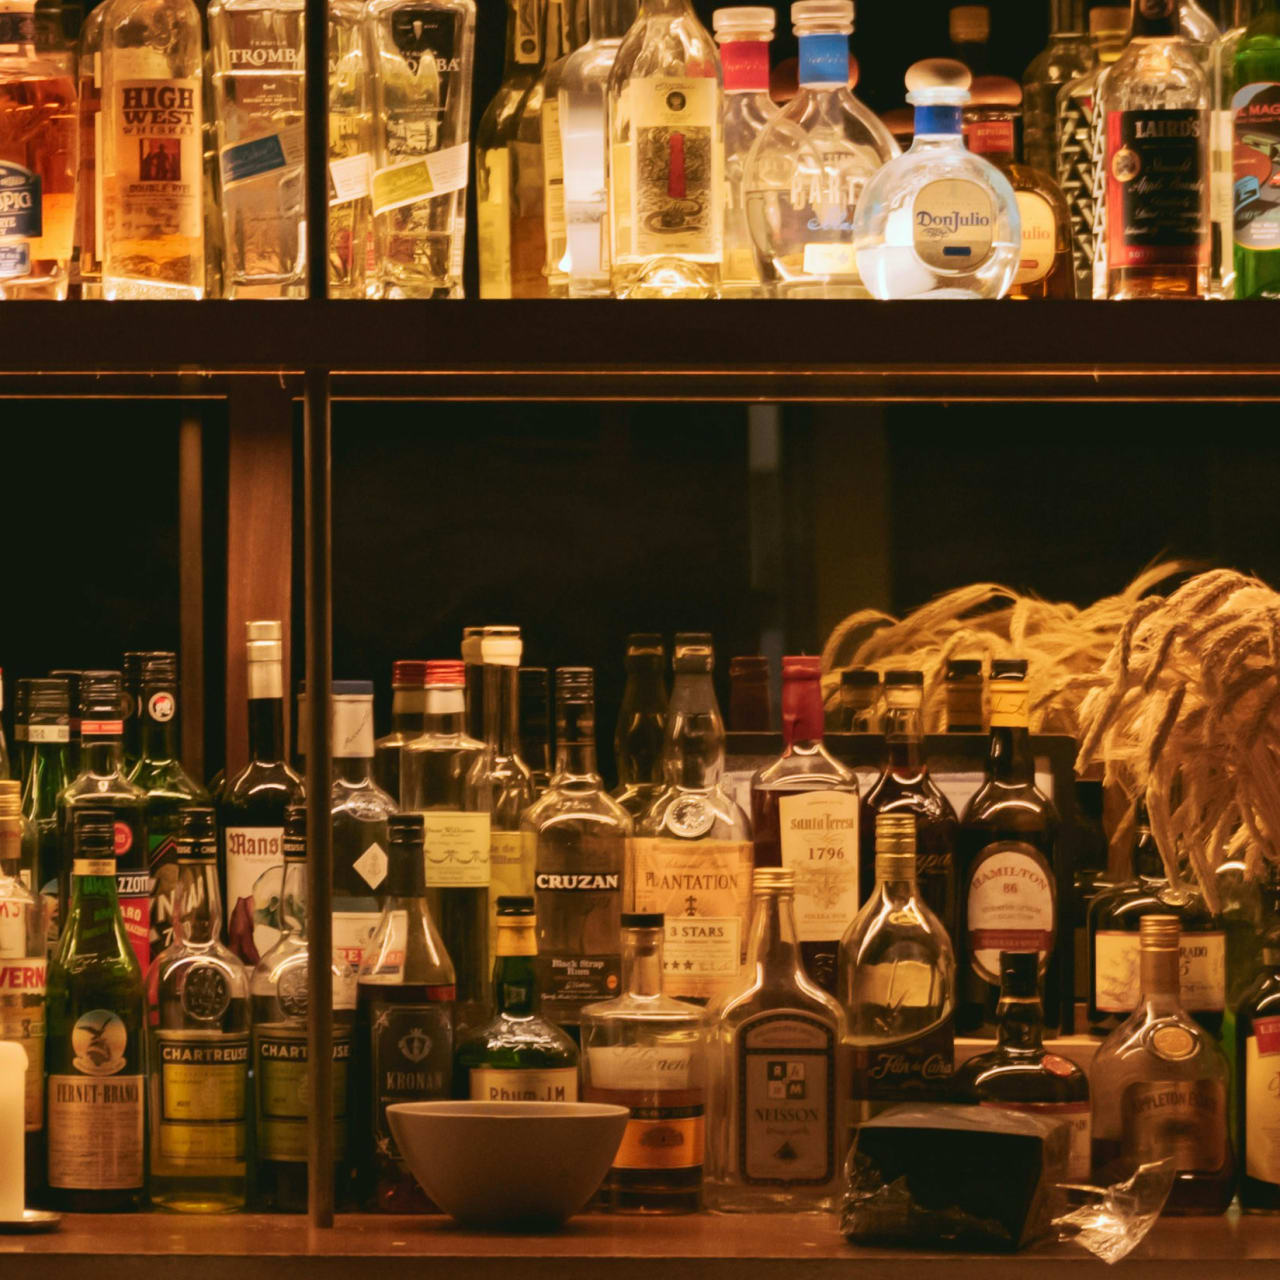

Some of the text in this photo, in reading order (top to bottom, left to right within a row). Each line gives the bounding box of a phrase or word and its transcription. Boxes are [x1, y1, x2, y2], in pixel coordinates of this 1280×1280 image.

[122, 86, 194, 110] HIGH
[123, 109, 194, 125] WEST
[1134, 118, 1201, 139] LAIRD'S
[1022, 227, 1051, 241] ulio
[807, 847, 846, 861] 1796
[535, 873, 619, 890] CRUZAN
[644, 871, 740, 892] PLANTATION
[971, 865, 1049, 891] HAMILTON
[669, 926, 725, 938] 3 STARS
[161, 1046, 249, 1062] CHARTREUSE
[385, 1070, 444, 1091] KRONAN
[490, 1086, 537, 1102] Rhum
[753, 1107, 820, 1122] NEISSON
